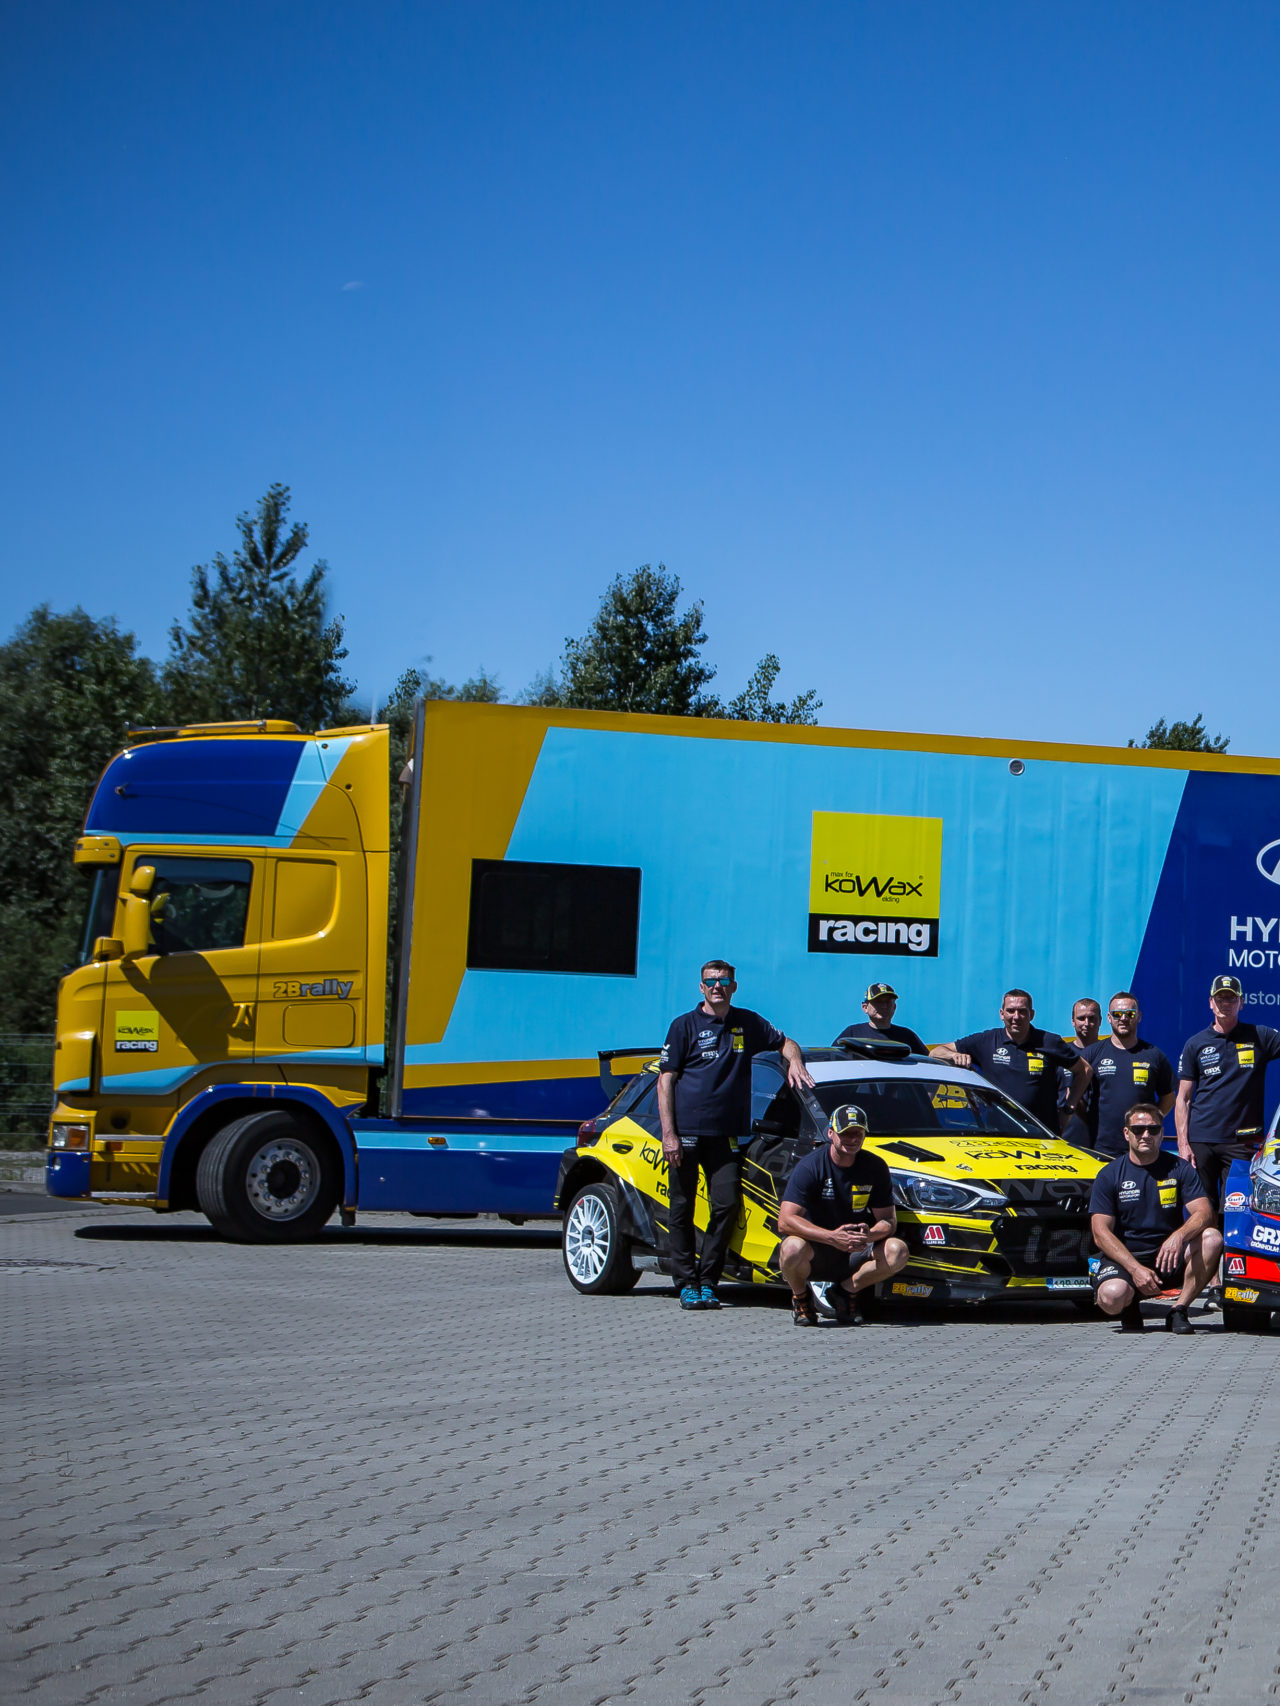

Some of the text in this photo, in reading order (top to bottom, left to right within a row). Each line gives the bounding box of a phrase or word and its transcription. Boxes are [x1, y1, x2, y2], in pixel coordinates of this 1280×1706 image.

[825, 874, 923, 898] koWax
[819, 919, 931, 952] racing
[273, 979, 353, 999] 2Brally
[116, 1041, 158, 1051] racing
[1014, 1164, 1079, 1173] racing
[892, 1283, 934, 1298] 2Brally
[1226, 1288, 1259, 1303] 2Brally
